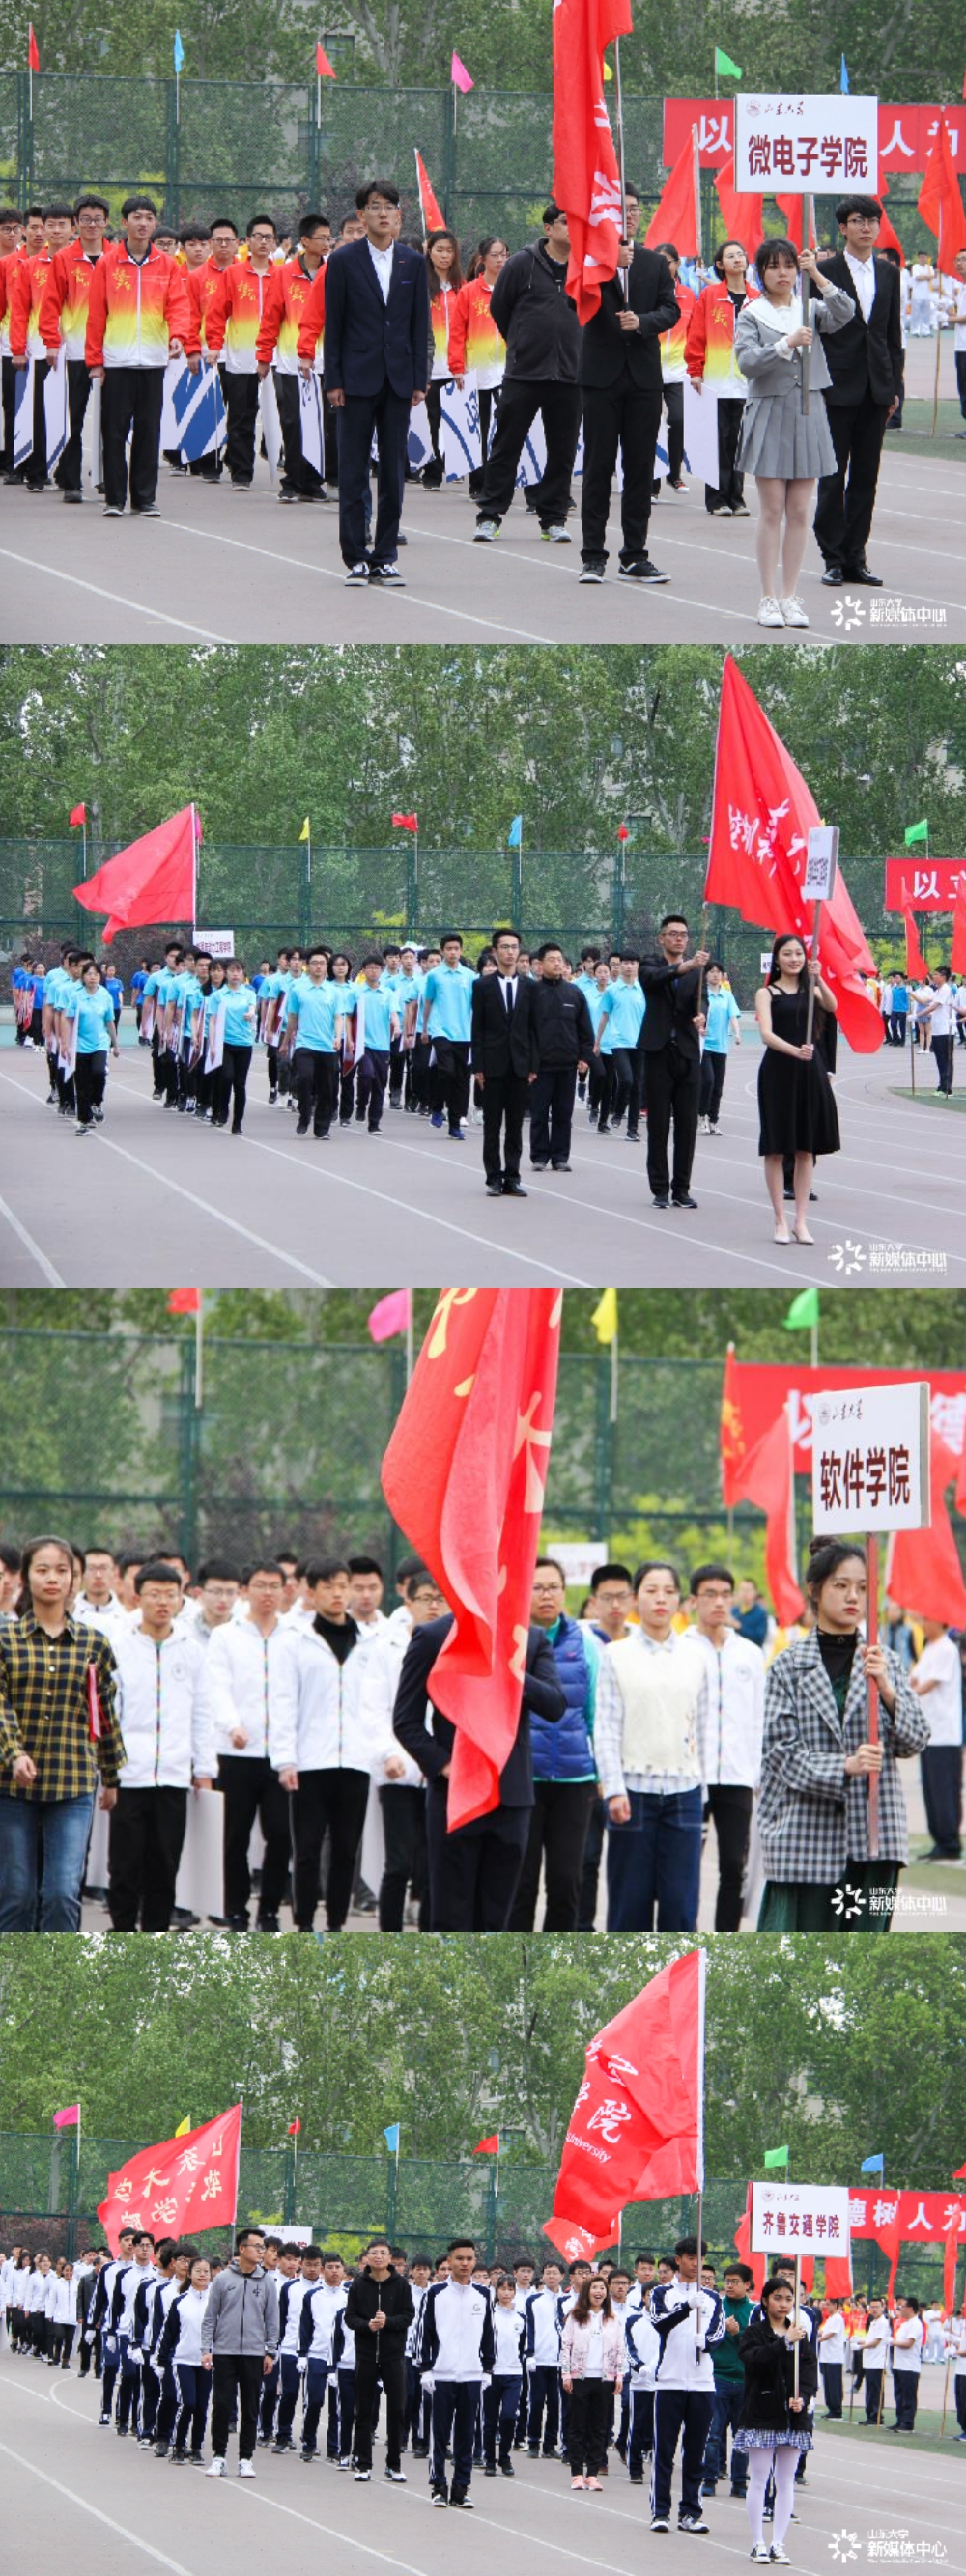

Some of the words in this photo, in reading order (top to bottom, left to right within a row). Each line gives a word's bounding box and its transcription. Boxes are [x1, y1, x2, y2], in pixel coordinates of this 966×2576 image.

[698, 115, 732, 153] 以
[749, 134, 867, 178] 微电子学院
[820, 1444, 911, 1512] 软件学院
[762, 2210, 840, 2239] 齐鲁交通学院
